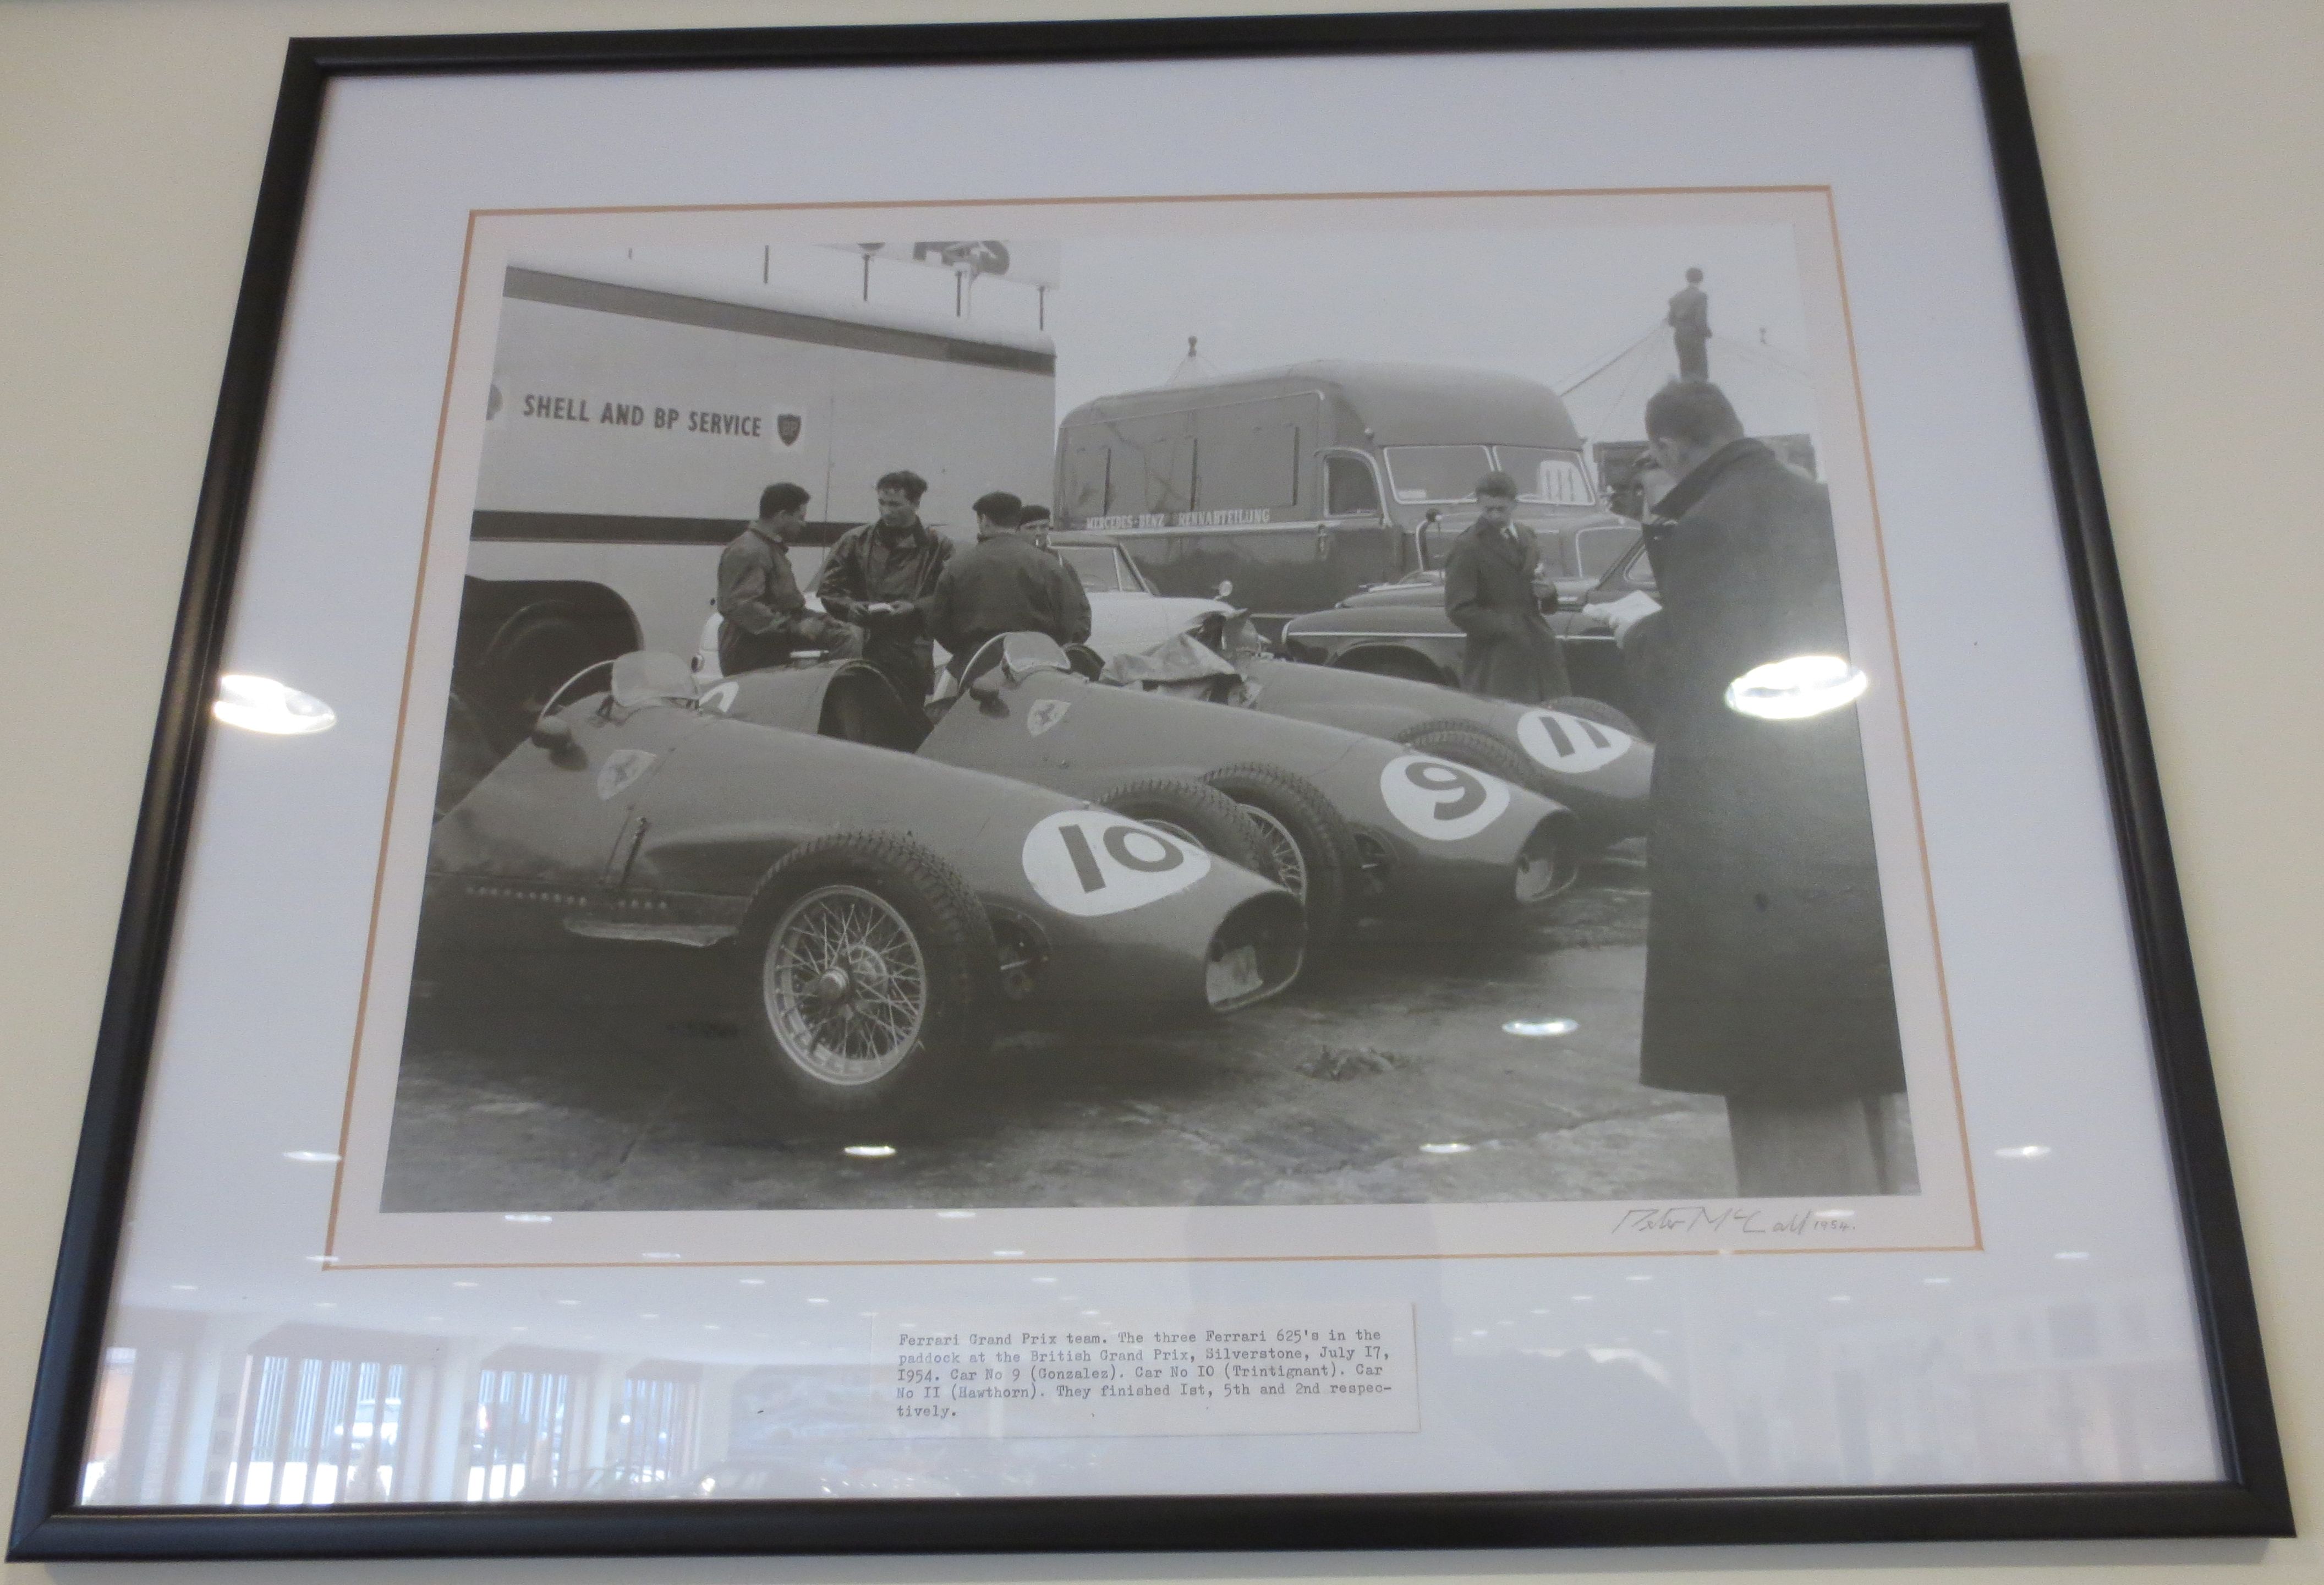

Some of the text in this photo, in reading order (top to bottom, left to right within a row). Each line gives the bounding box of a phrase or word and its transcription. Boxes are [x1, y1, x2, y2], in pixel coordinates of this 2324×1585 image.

[523, 393, 762, 438] SHELL AND BP SERVICE
[1405, 762, 1487, 821] 9
[1059, 824, 1184, 893] 10
[898, 1329, 1381, 1346] Ferrari Grand Prix team. The three Ferrari 625's in the
[898, 1352, 960, 1367] paddock
[969, 1352, 985, 1363] at
[995, 1351, 1021, 1363] the
[1031, 1350, 1092, 1363] British
[1100, 1349, 1143, 1362] Grand
[1153, 1348, 1195, 1363] Prix,
[1205, 1347, 1309, 1362] Silverstone,
[1319, 1346, 1356, 1362] July
[950, 1368, 977, 1381] Car
[985, 1368, 1002, 1380] No
[1012, 1368, 1021, 1382] 9
[1031, 1364, 1124, 1382] (Gonzalez).
[1134, 1366, 1163, 1379] Car
[1170, 1365, 1188, 1378] No
[1224, 1362, 1345, 1380] (Trintignant).
[1355, 1363, 1383, 1376] Car
[896, 1387, 914, 1399] No
[951, 1383, 1045, 1401] (Hawthorn).
[1056, 1384, 1092, 1400] They
[1100, 1384, 1170, 1397] finished
[1224, 1383, 1251, 1398] 5th
[1260, 1382, 1286, 1395] and
[1295, 1382, 1320, 1395] 2nd
[1329, 1384, 1392, 1396] respec-
[896, 1404, 957, 1420] tively.
